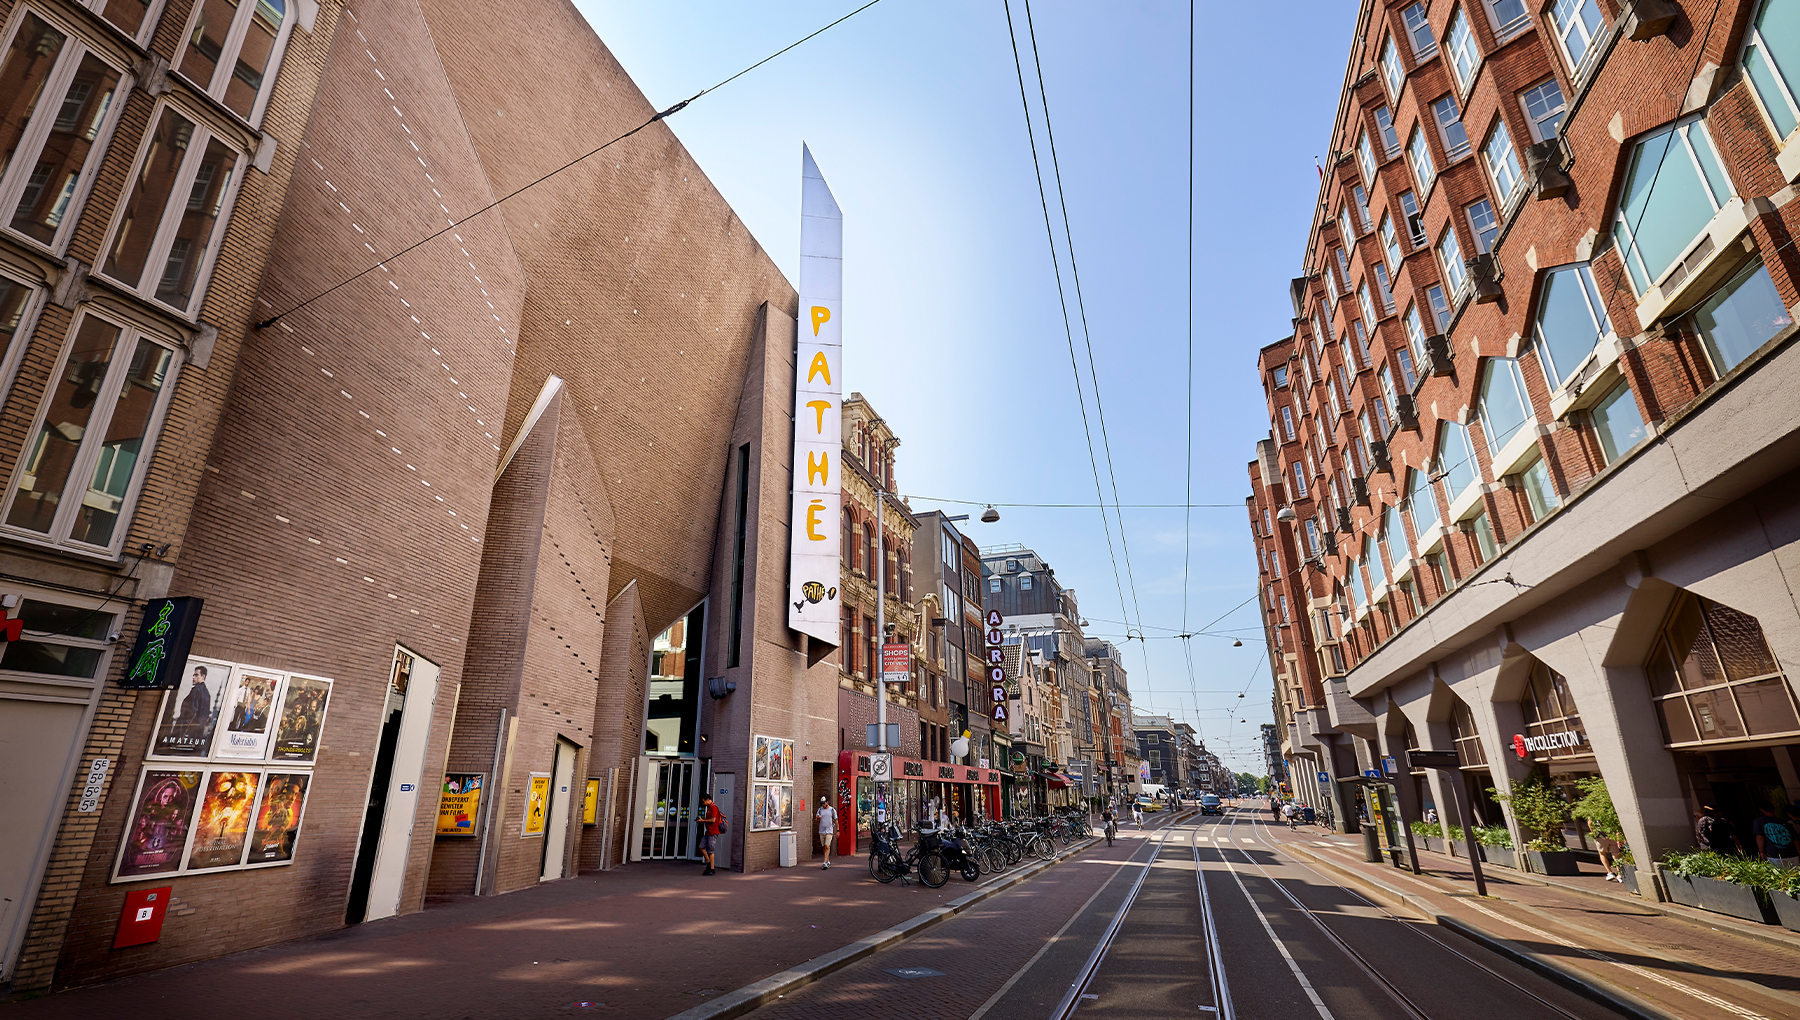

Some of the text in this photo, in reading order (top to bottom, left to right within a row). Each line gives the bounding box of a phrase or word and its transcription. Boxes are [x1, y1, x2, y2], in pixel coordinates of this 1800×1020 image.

[989, 611, 1006, 719] AURORA
[162, 736, 206, 746] AMATEUR
[1534, 730, 1580, 751] COLLECTION
[94, 760, 107, 770] 5E
[90, 773, 103, 784] 5D
[85, 786, 99, 797] 5C
[81, 800, 96, 811] 5B
